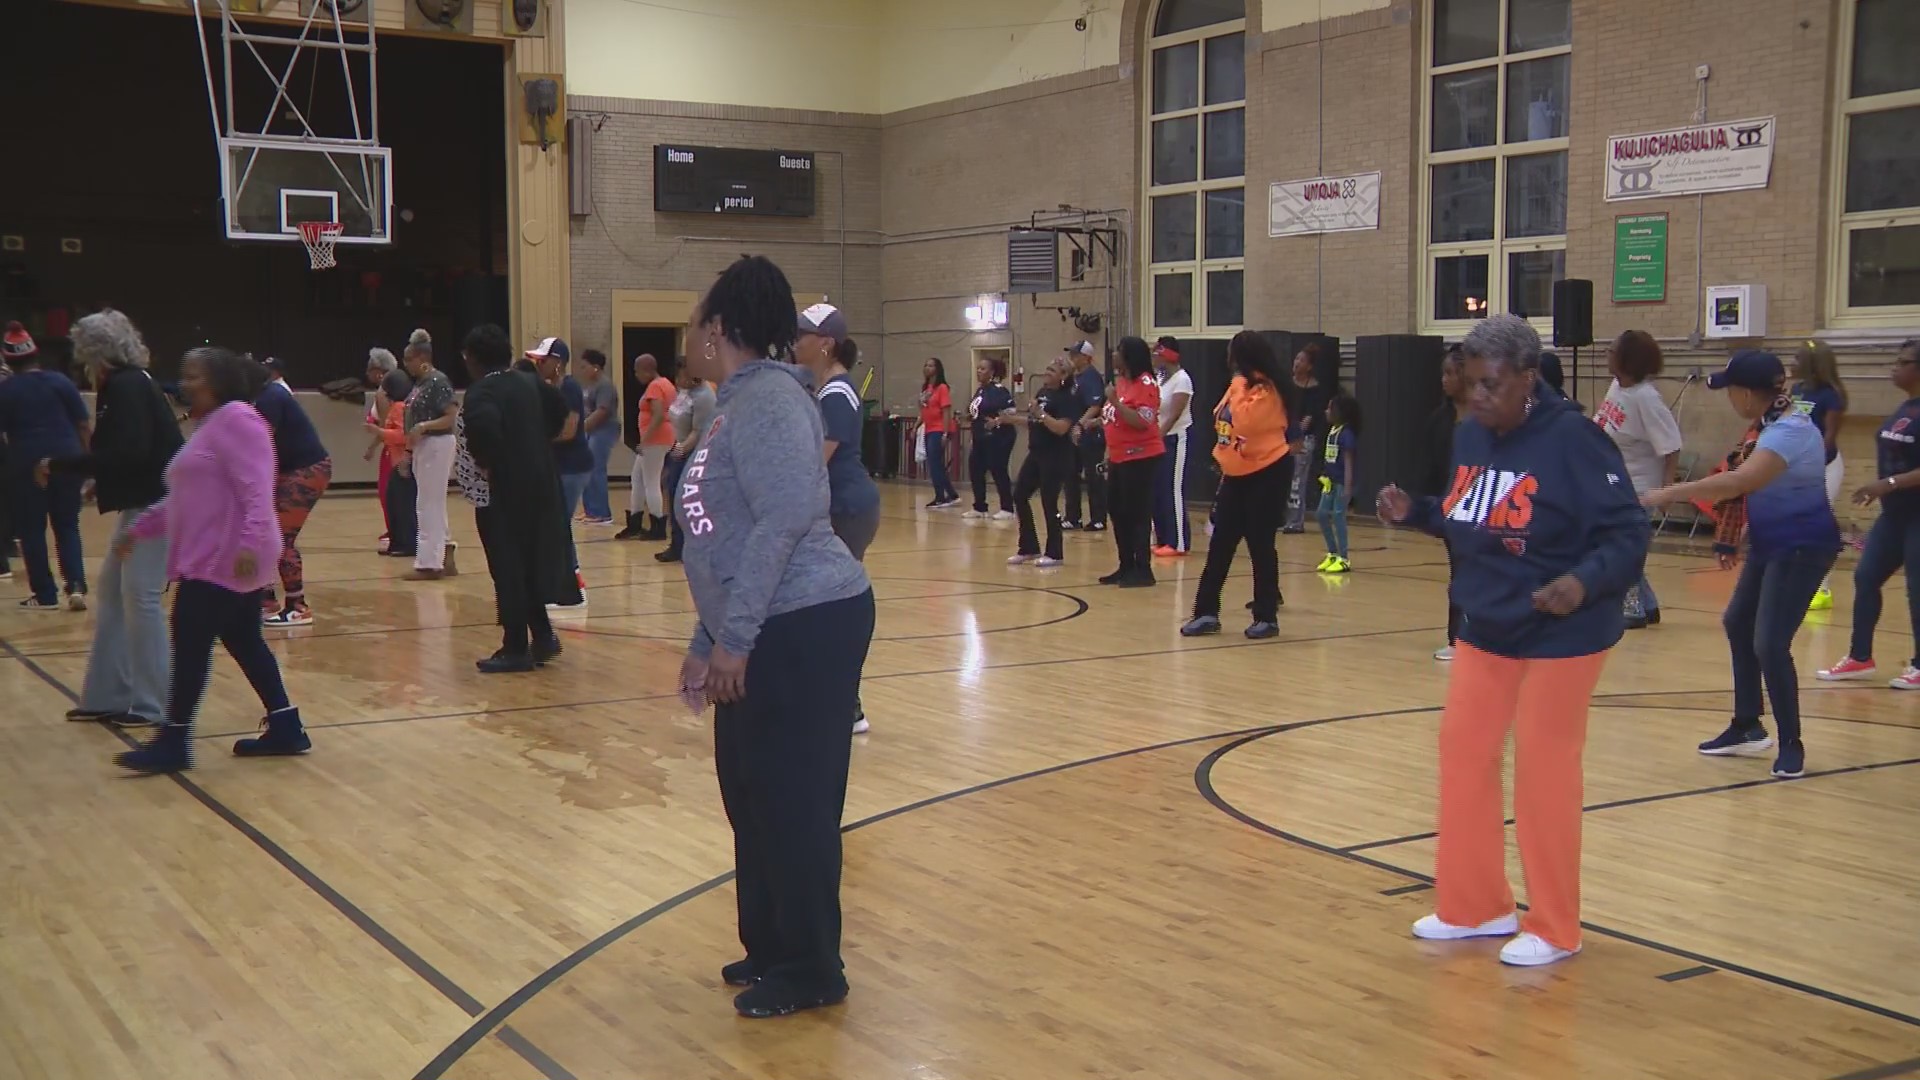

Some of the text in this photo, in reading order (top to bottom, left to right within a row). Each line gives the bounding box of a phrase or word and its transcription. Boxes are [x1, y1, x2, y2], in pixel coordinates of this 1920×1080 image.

[1614, 128, 1729, 161] KUJICHAGULIA
[668, 148, 694, 163] Home
[780, 155, 810, 169] Guests
[1303, 182, 1340, 201] UMOJA
[724, 197, 754, 209] period
[681, 448, 714, 536] BEARS
